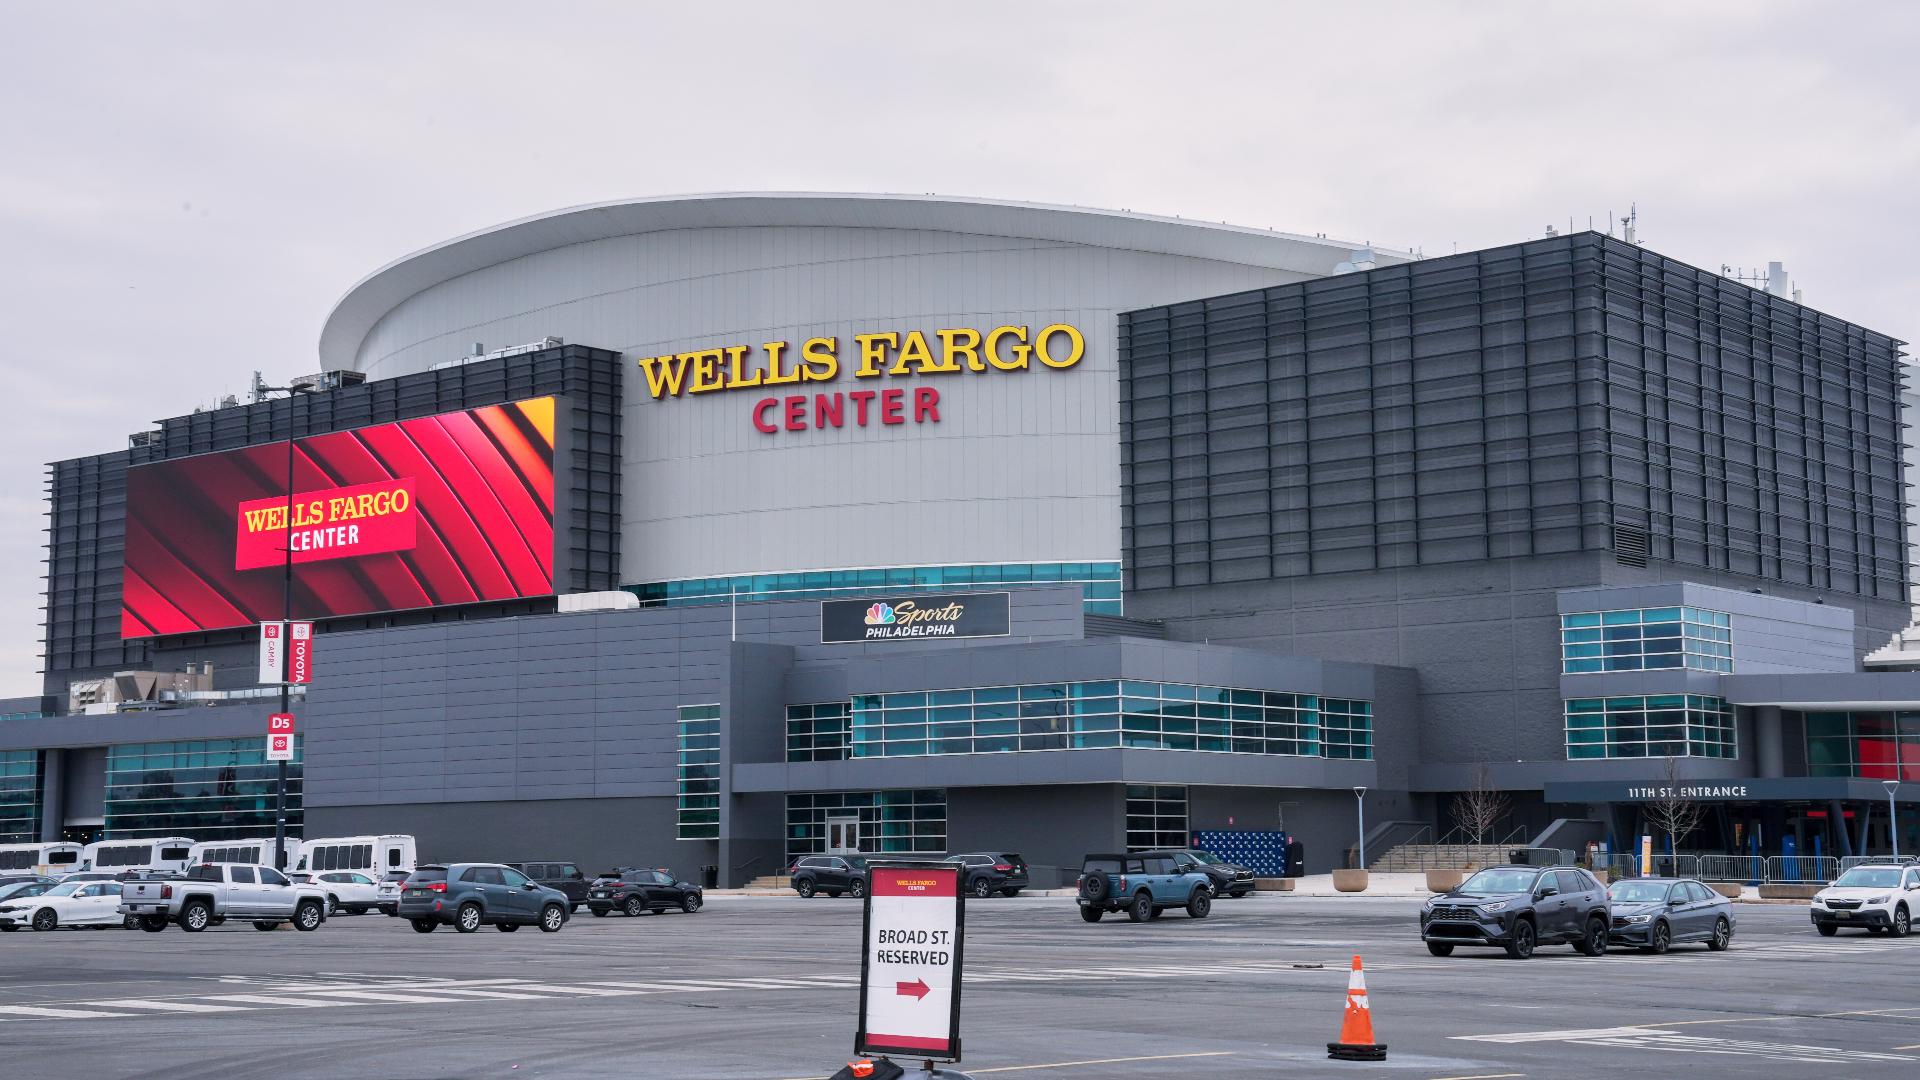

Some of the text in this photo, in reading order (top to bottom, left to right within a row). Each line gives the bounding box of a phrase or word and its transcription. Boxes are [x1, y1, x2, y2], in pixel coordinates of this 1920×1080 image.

[639, 323, 1085, 399] WELLS FARGO
[752, 387, 941, 434] CENTER
[245, 489, 409, 533] WELLS FARGO
[290, 525, 359, 551] CENTER
[894, 601, 964, 628] Sports
[866, 625, 955, 638] PHILADELPHIA
[295, 640, 305, 682] TOYOTA
[272, 717, 290, 729] D5
[1629, 786, 1747, 797] 11TH ST. ENTRANCE
[878, 930, 950, 944] BROAD ST.
[877, 950, 948, 965] RESERVED
